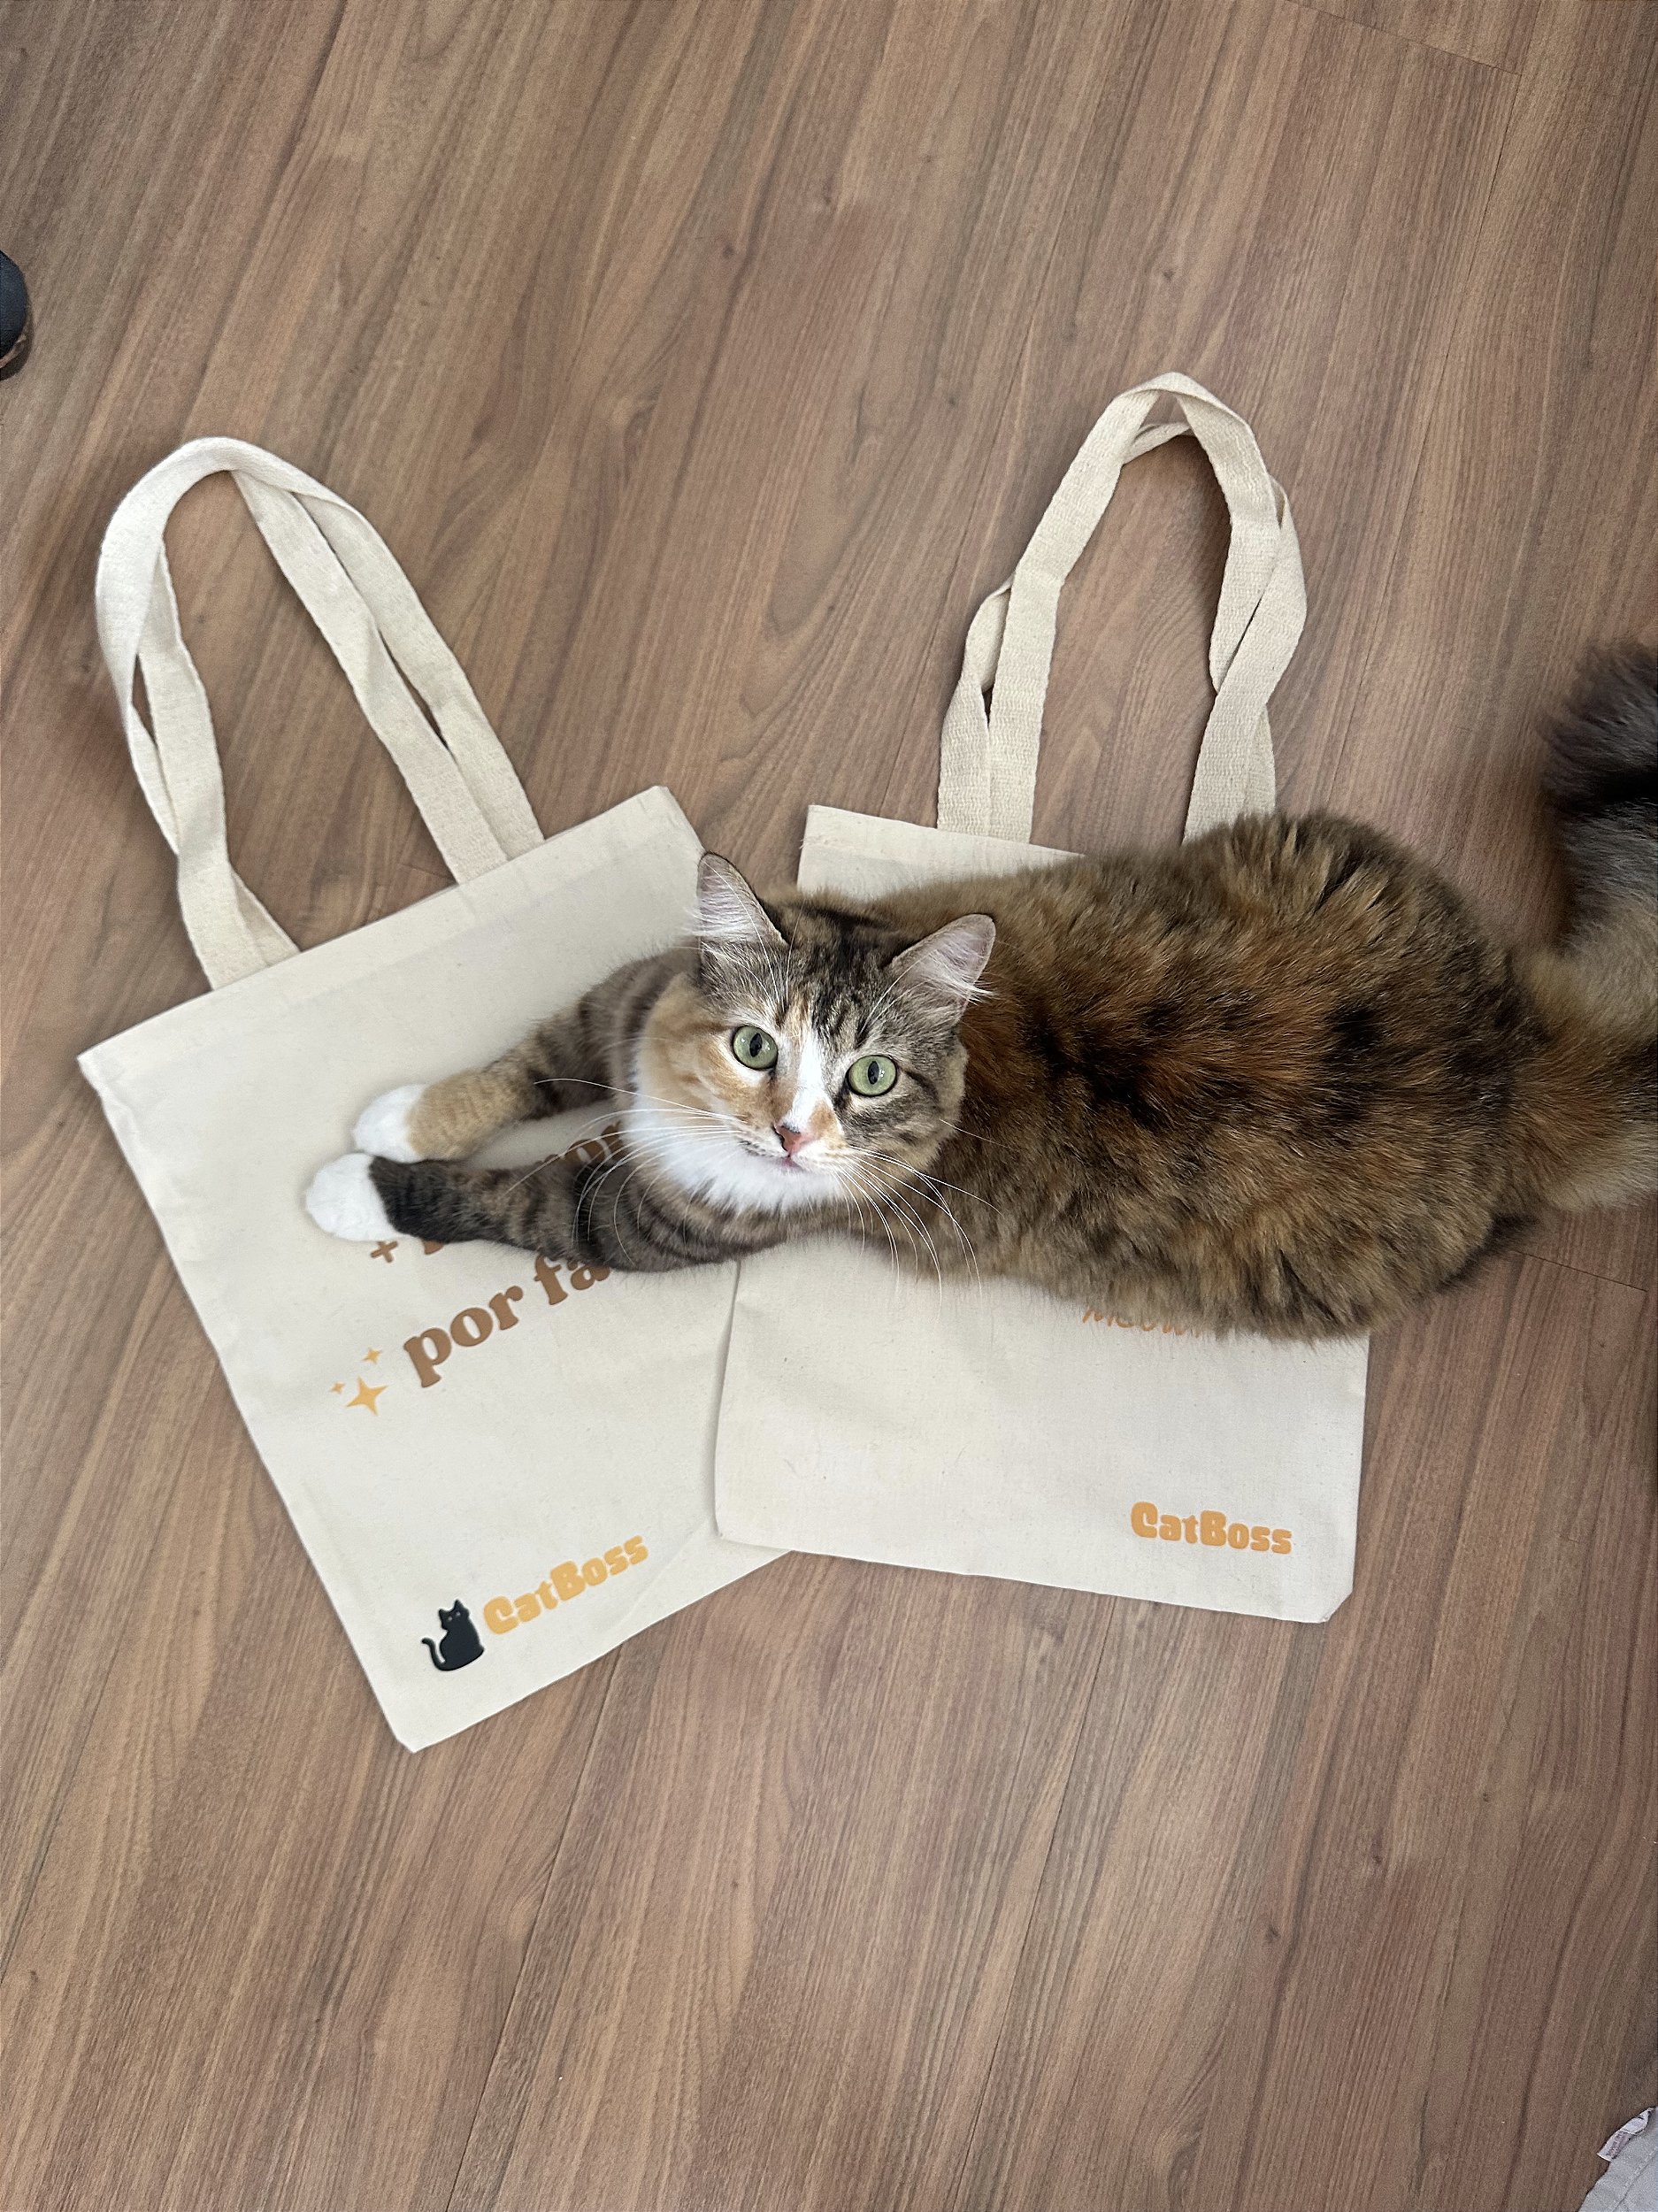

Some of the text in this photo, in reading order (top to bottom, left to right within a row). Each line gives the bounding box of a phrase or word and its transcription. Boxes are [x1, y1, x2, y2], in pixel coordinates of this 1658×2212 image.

[403, 1254, 611, 1388] por fa
[1130, 1501, 1293, 1555] CatBoss
[483, 1534, 649, 1634] CatBoss
